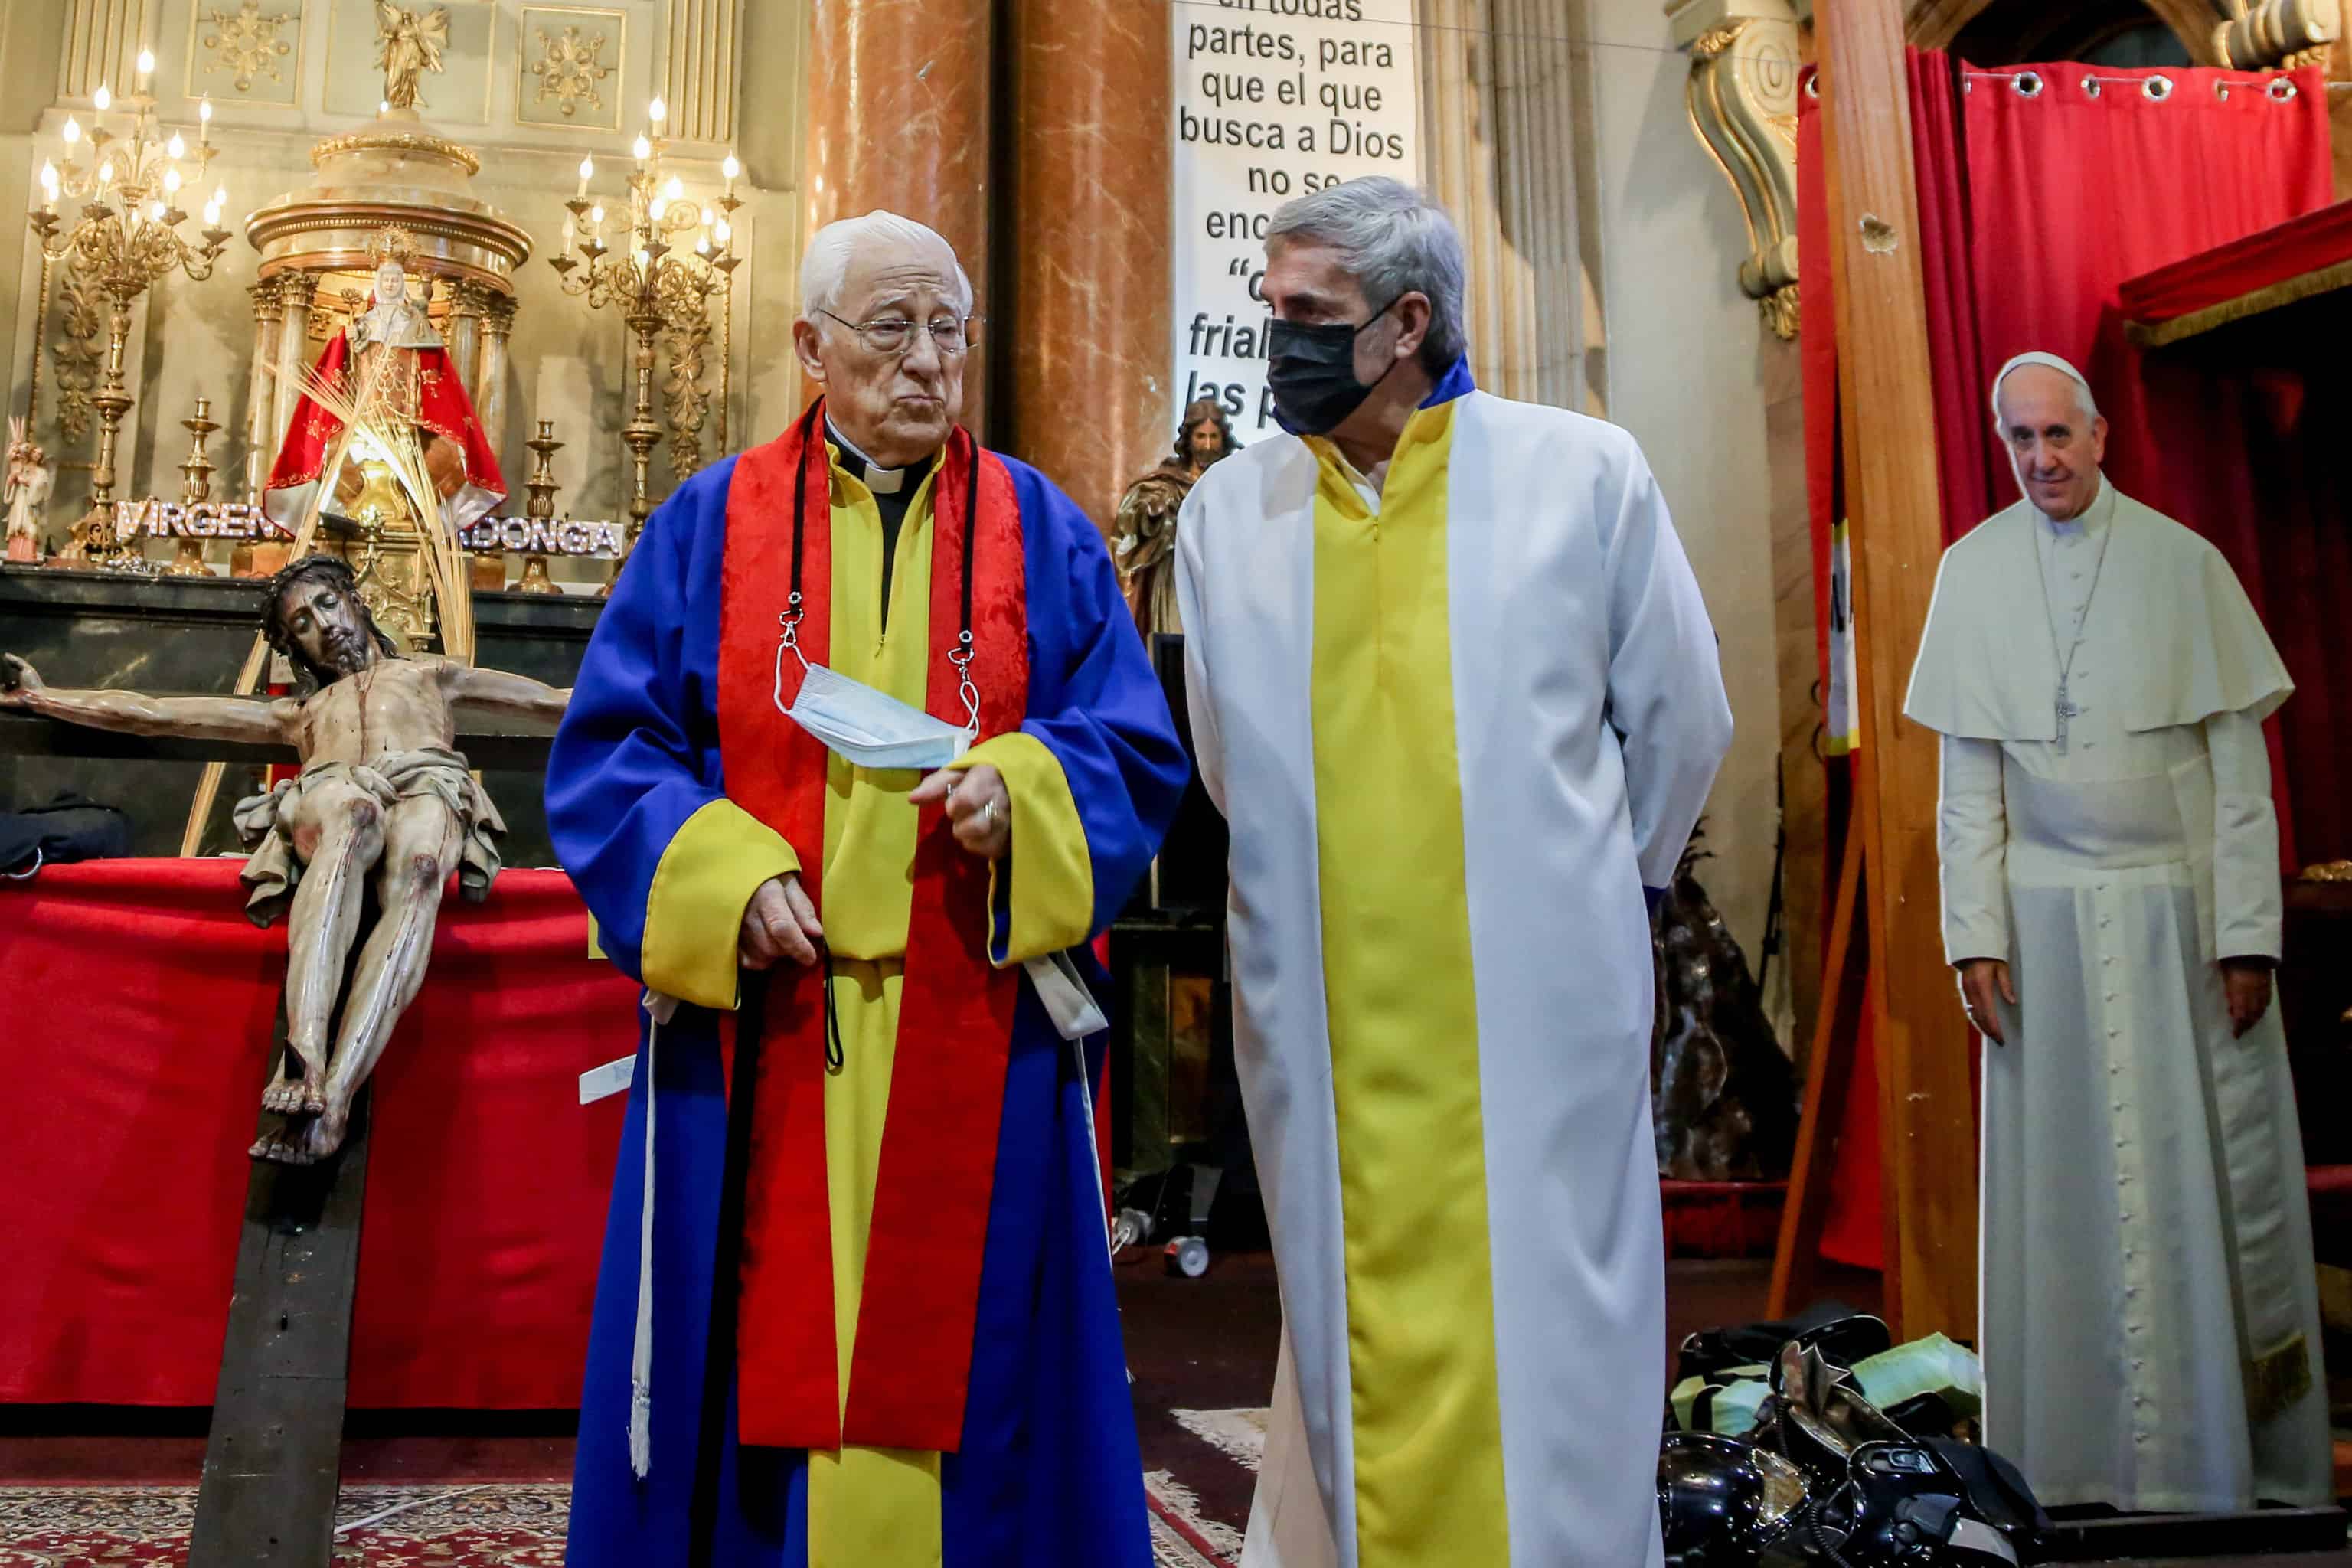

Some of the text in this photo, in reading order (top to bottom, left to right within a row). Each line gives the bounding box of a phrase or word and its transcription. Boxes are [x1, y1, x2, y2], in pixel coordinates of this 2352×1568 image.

[1188, 23, 1393, 72] partes, para
[1201, 71, 1383, 116] que el que
[1180, 106, 1404, 160] busca a Dios
[1249, 166, 1291, 195] no
[116, 500, 275, 539] VIRGEN
